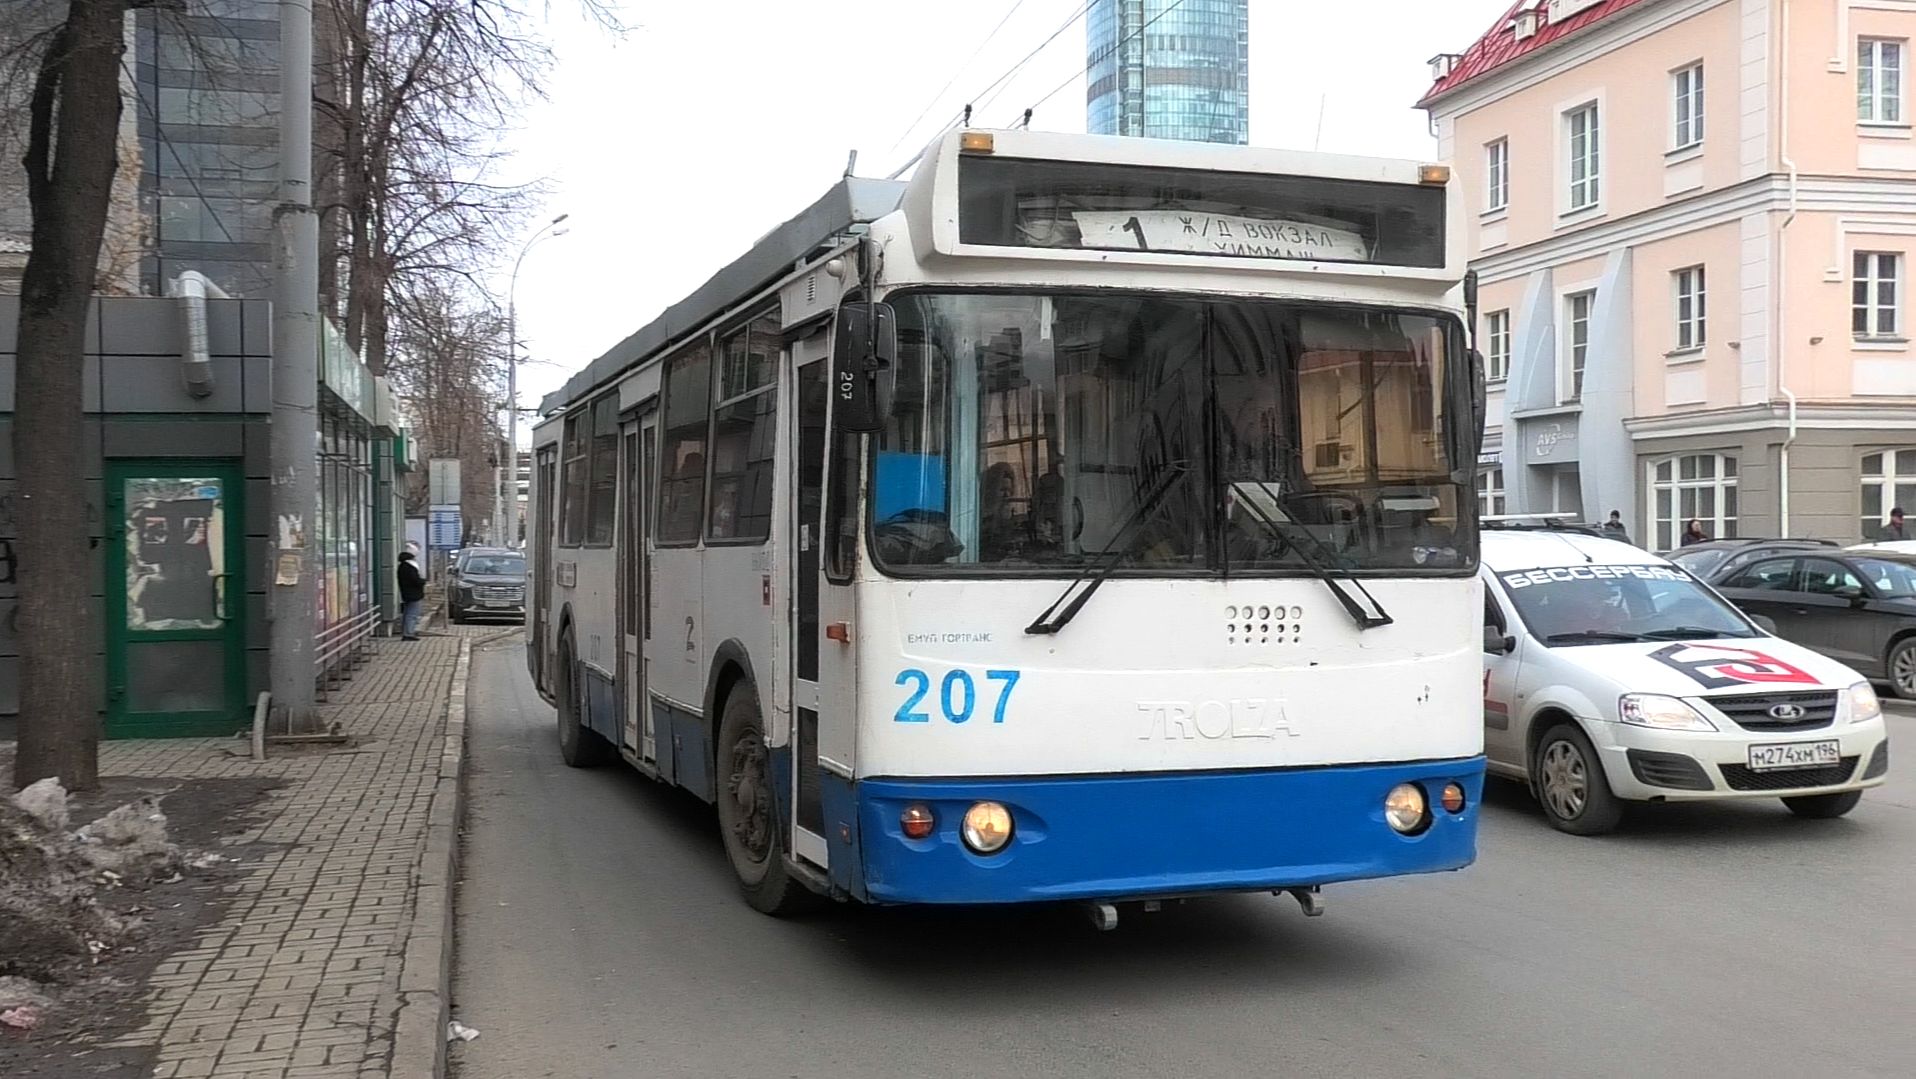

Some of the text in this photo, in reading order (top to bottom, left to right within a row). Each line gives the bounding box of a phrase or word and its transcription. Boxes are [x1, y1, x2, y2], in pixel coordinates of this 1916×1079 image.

[1122, 215, 1333, 250] 1 Ж/Д ВОКЗАЛ
[840, 371, 854, 401] 207
[1502, 564, 1693, 589] БЕССЕРБАУ
[893, 668, 1021, 724] 207
[1137, 699, 1300, 741] TROLZA
